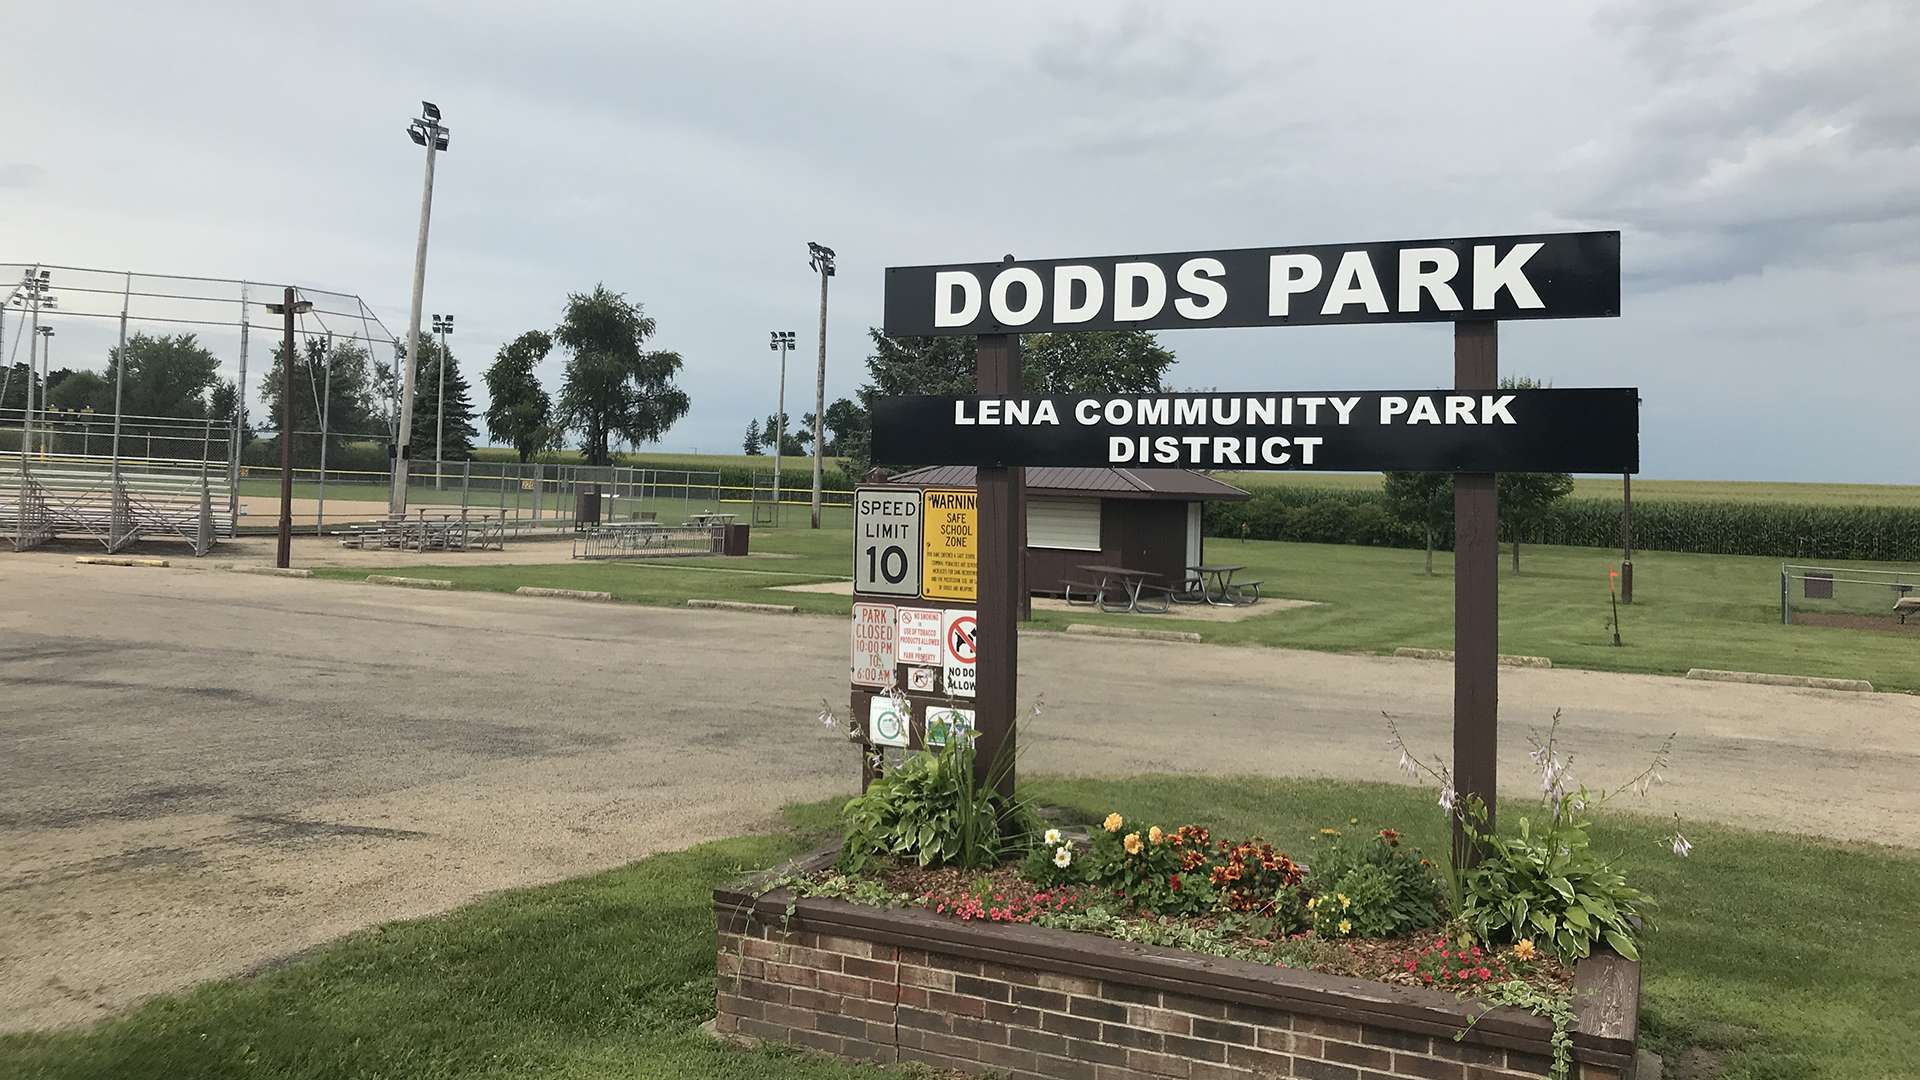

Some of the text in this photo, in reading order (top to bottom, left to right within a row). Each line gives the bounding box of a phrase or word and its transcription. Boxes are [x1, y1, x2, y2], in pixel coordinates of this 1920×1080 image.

[934, 242, 1547, 328] DODDS PARK
[954, 395, 1518, 427] LENA COMMUNITY PARK
[1108, 435, 1324, 465] DISTRICT
[860, 500, 916, 516] SPEED
[931, 494, 977, 510] WARNIN
[946, 513, 967, 525] SAFE
[866, 523, 910, 539] LIMIT
[940, 524, 973, 536] SCHOOL
[945, 536, 968, 548] ZONE
[866, 545, 908, 584] 10
[862, 607, 887, 623] PARK
[856, 624, 893, 640] CLOSED
[856, 640, 892, 654] 10:00 PM
[869, 654, 879, 667] TO
[857, 667, 877, 681] 6:00
[948, 667, 975, 678] NO DO
[947, 679, 976, 691] ALLOW
